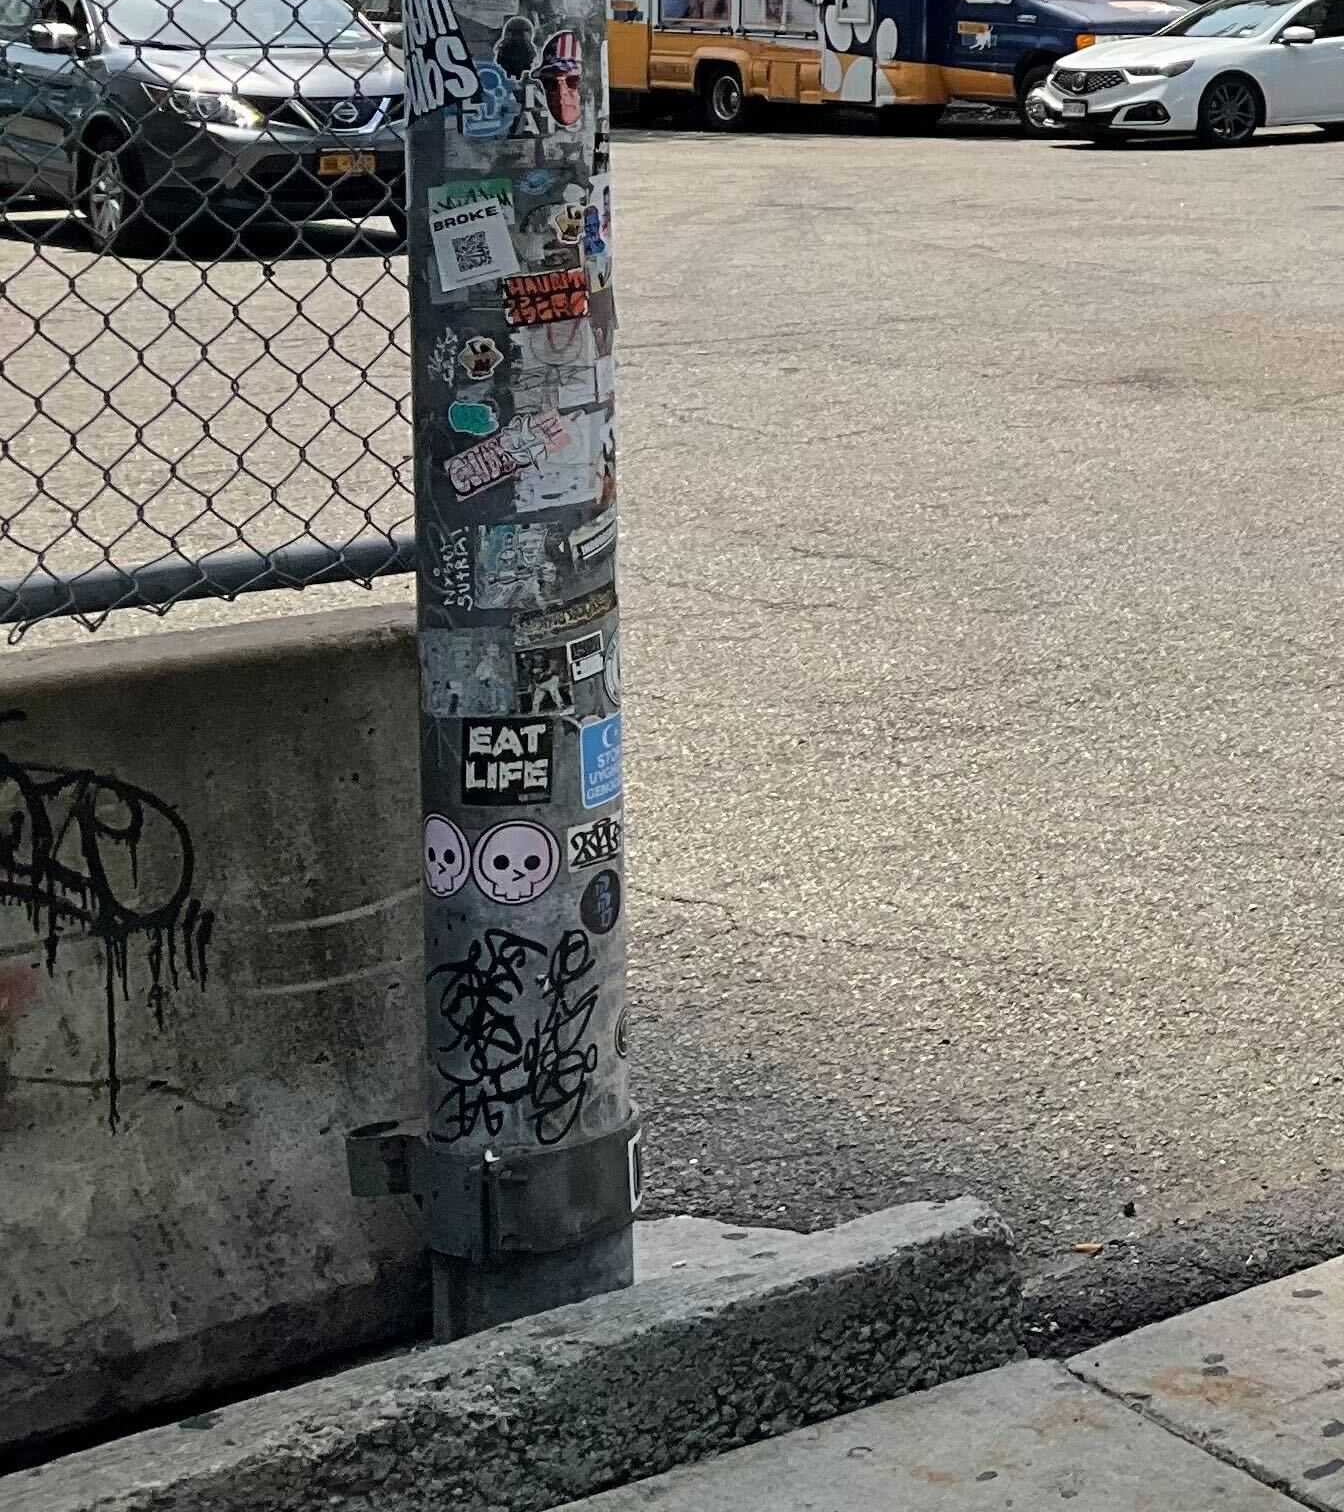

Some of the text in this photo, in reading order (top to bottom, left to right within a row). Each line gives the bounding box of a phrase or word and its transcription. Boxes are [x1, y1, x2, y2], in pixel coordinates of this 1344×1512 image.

[433, 206, 499, 232] BROKE
[469, 724, 547, 757] EAT
[465, 758, 548, 791] LIFE
